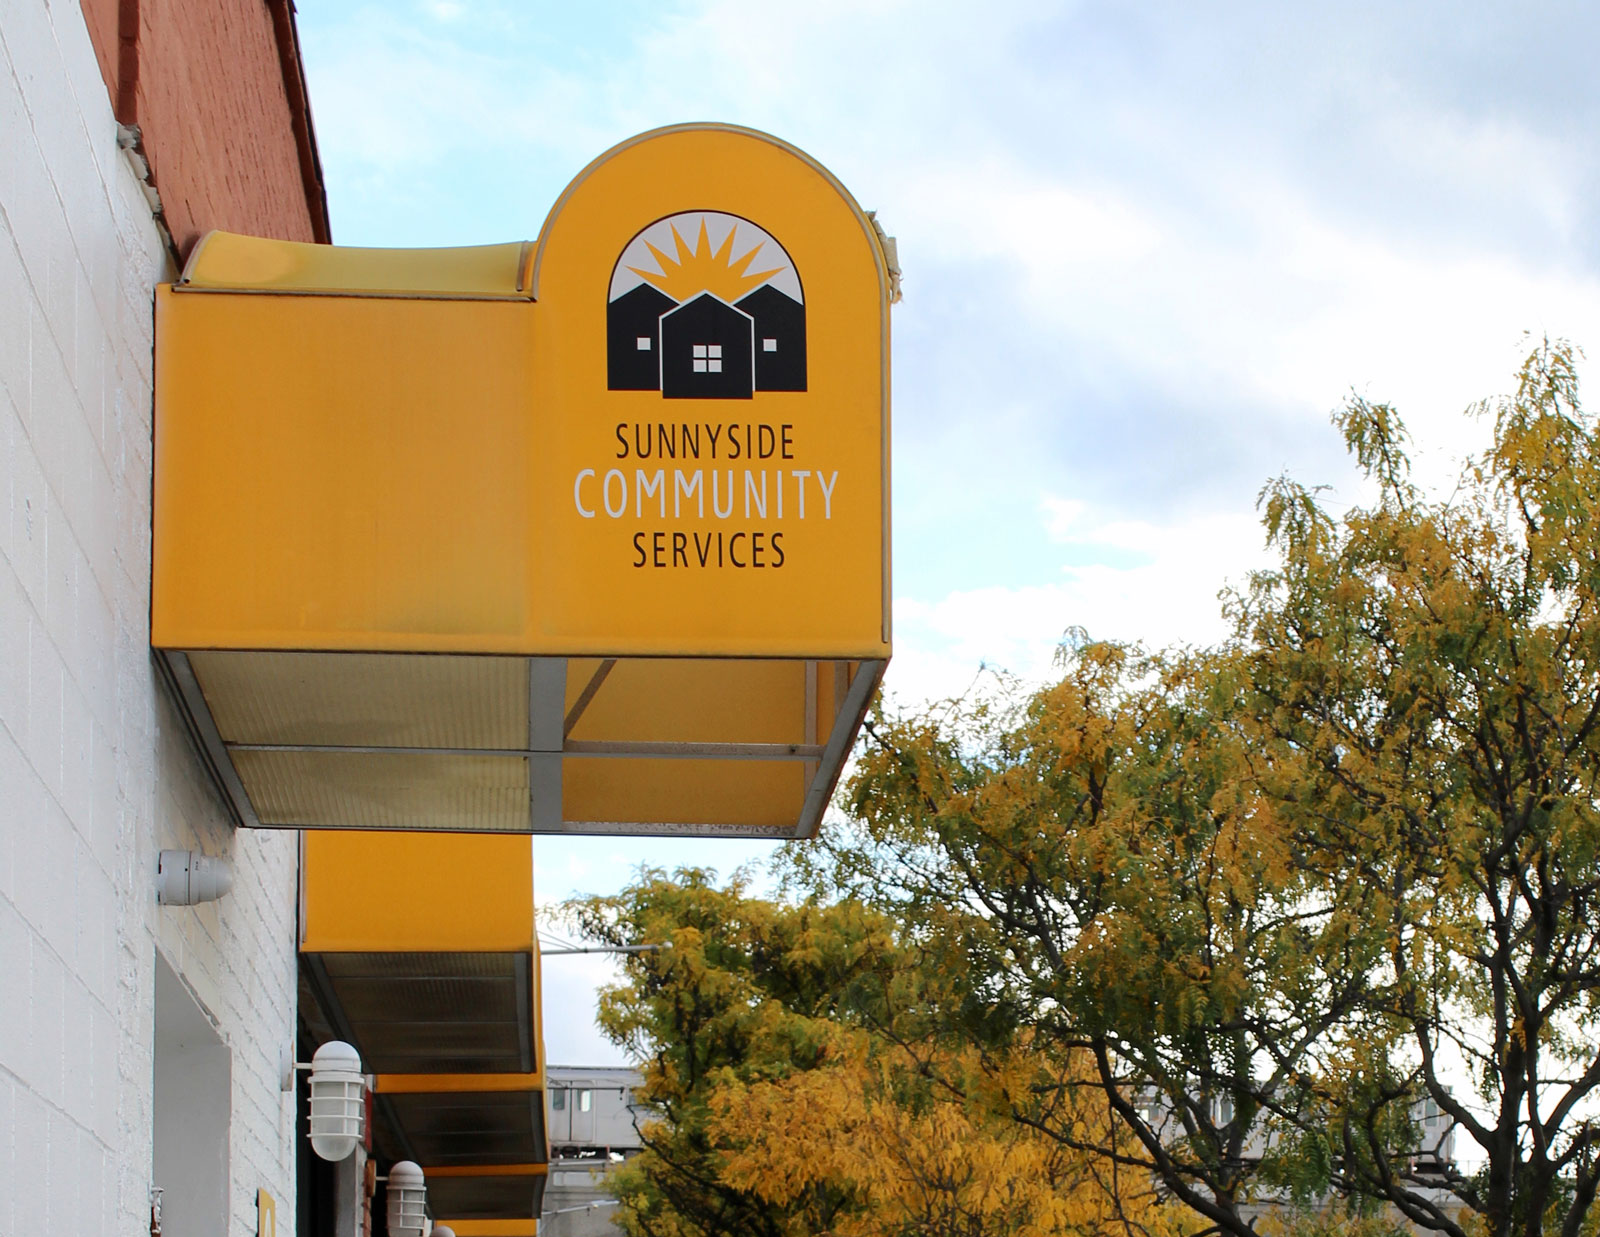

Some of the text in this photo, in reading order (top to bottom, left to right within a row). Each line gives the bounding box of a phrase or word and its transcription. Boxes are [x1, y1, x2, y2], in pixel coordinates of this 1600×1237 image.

[615, 423, 794, 459] SUNNYSIDE
[574, 468, 839, 519] COMMUNITY
[633, 532, 784, 567] SERVICES
